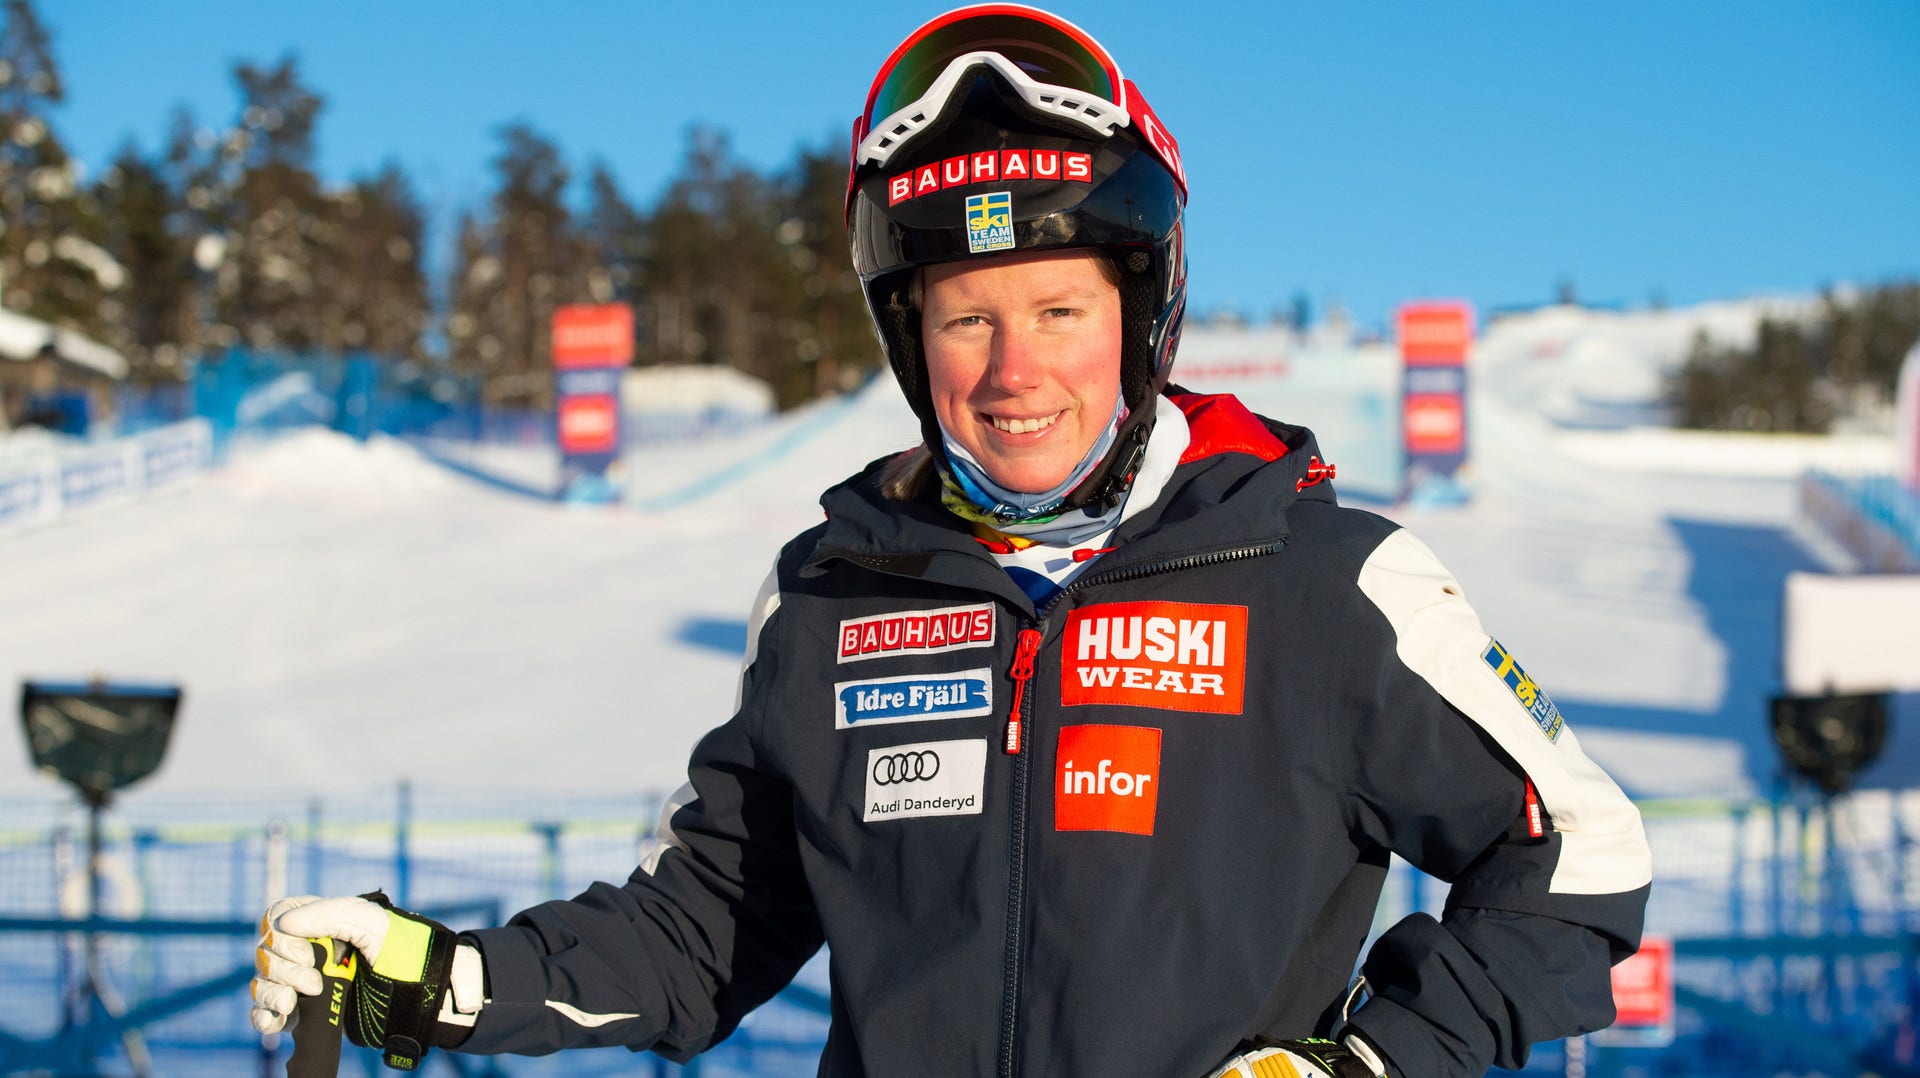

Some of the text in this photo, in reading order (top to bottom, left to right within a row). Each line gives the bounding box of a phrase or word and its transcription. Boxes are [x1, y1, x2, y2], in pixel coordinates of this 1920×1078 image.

[891, 153, 1088, 201] BAUHAUS
[970, 214, 1009, 230] SKI
[971, 227, 1010, 239] TEAM
[972, 236, 1011, 246] SWEDEN
[844, 613, 989, 651] BAUHAUS
[1077, 616, 1226, 667] HUSKI
[1077, 666, 1225, 696] WEAR
[856, 682, 967, 712] Idre Fjäll
[1007, 721, 1018, 750] HUSKI
[1064, 759, 1151, 797] infor
[870, 795, 975, 814] Audi Danderyd
[1529, 803, 1543, 834] HUSKI
[328, 981, 344, 1027] LEKI
